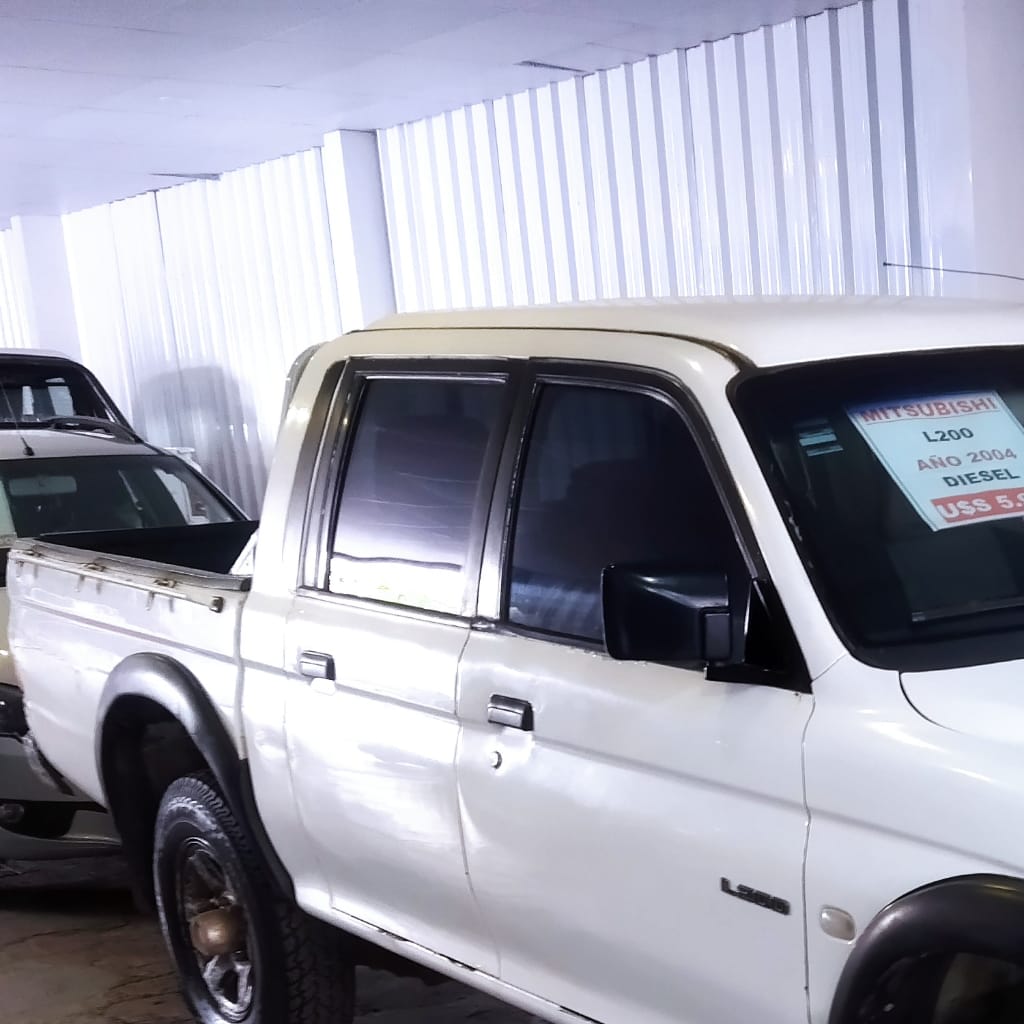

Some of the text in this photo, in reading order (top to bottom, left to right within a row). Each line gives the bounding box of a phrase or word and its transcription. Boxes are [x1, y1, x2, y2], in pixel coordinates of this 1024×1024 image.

[860, 397, 997, 422] MITSUBISHI
[922, 427, 974, 443] L200
[917, 448, 1017, 471] AÑO 2004
[942, 468, 1020, 488] DIESEL
